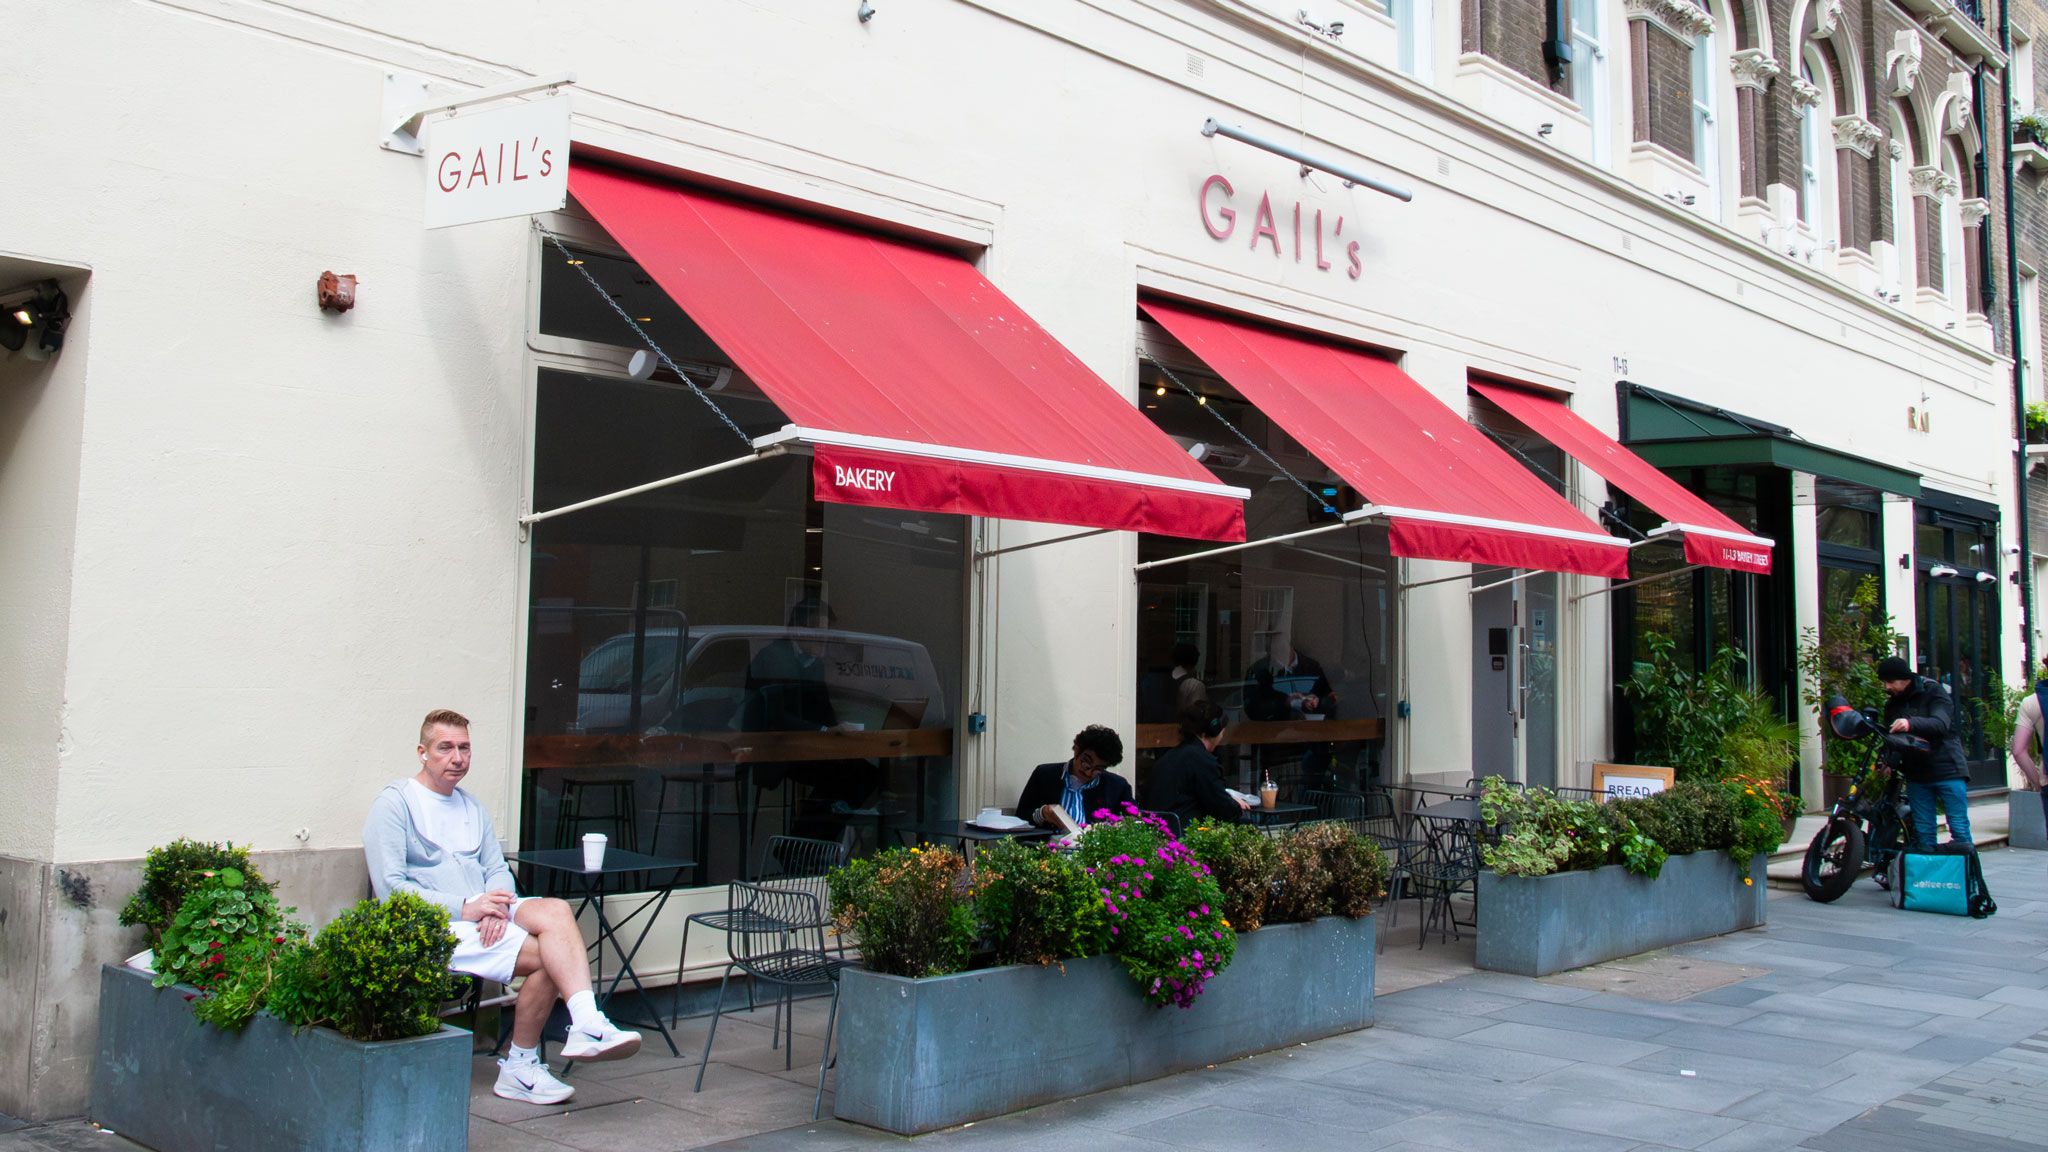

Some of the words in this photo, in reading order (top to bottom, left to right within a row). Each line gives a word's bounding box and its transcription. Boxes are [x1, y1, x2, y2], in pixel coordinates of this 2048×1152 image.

[438, 136, 552, 193] GAIL's
[1200, 174, 1362, 280] GAIL's
[835, 464, 896, 492] BAKERY
[1722, 548, 1737, 561] 11-13
[1608, 784, 1651, 797] BREAD
